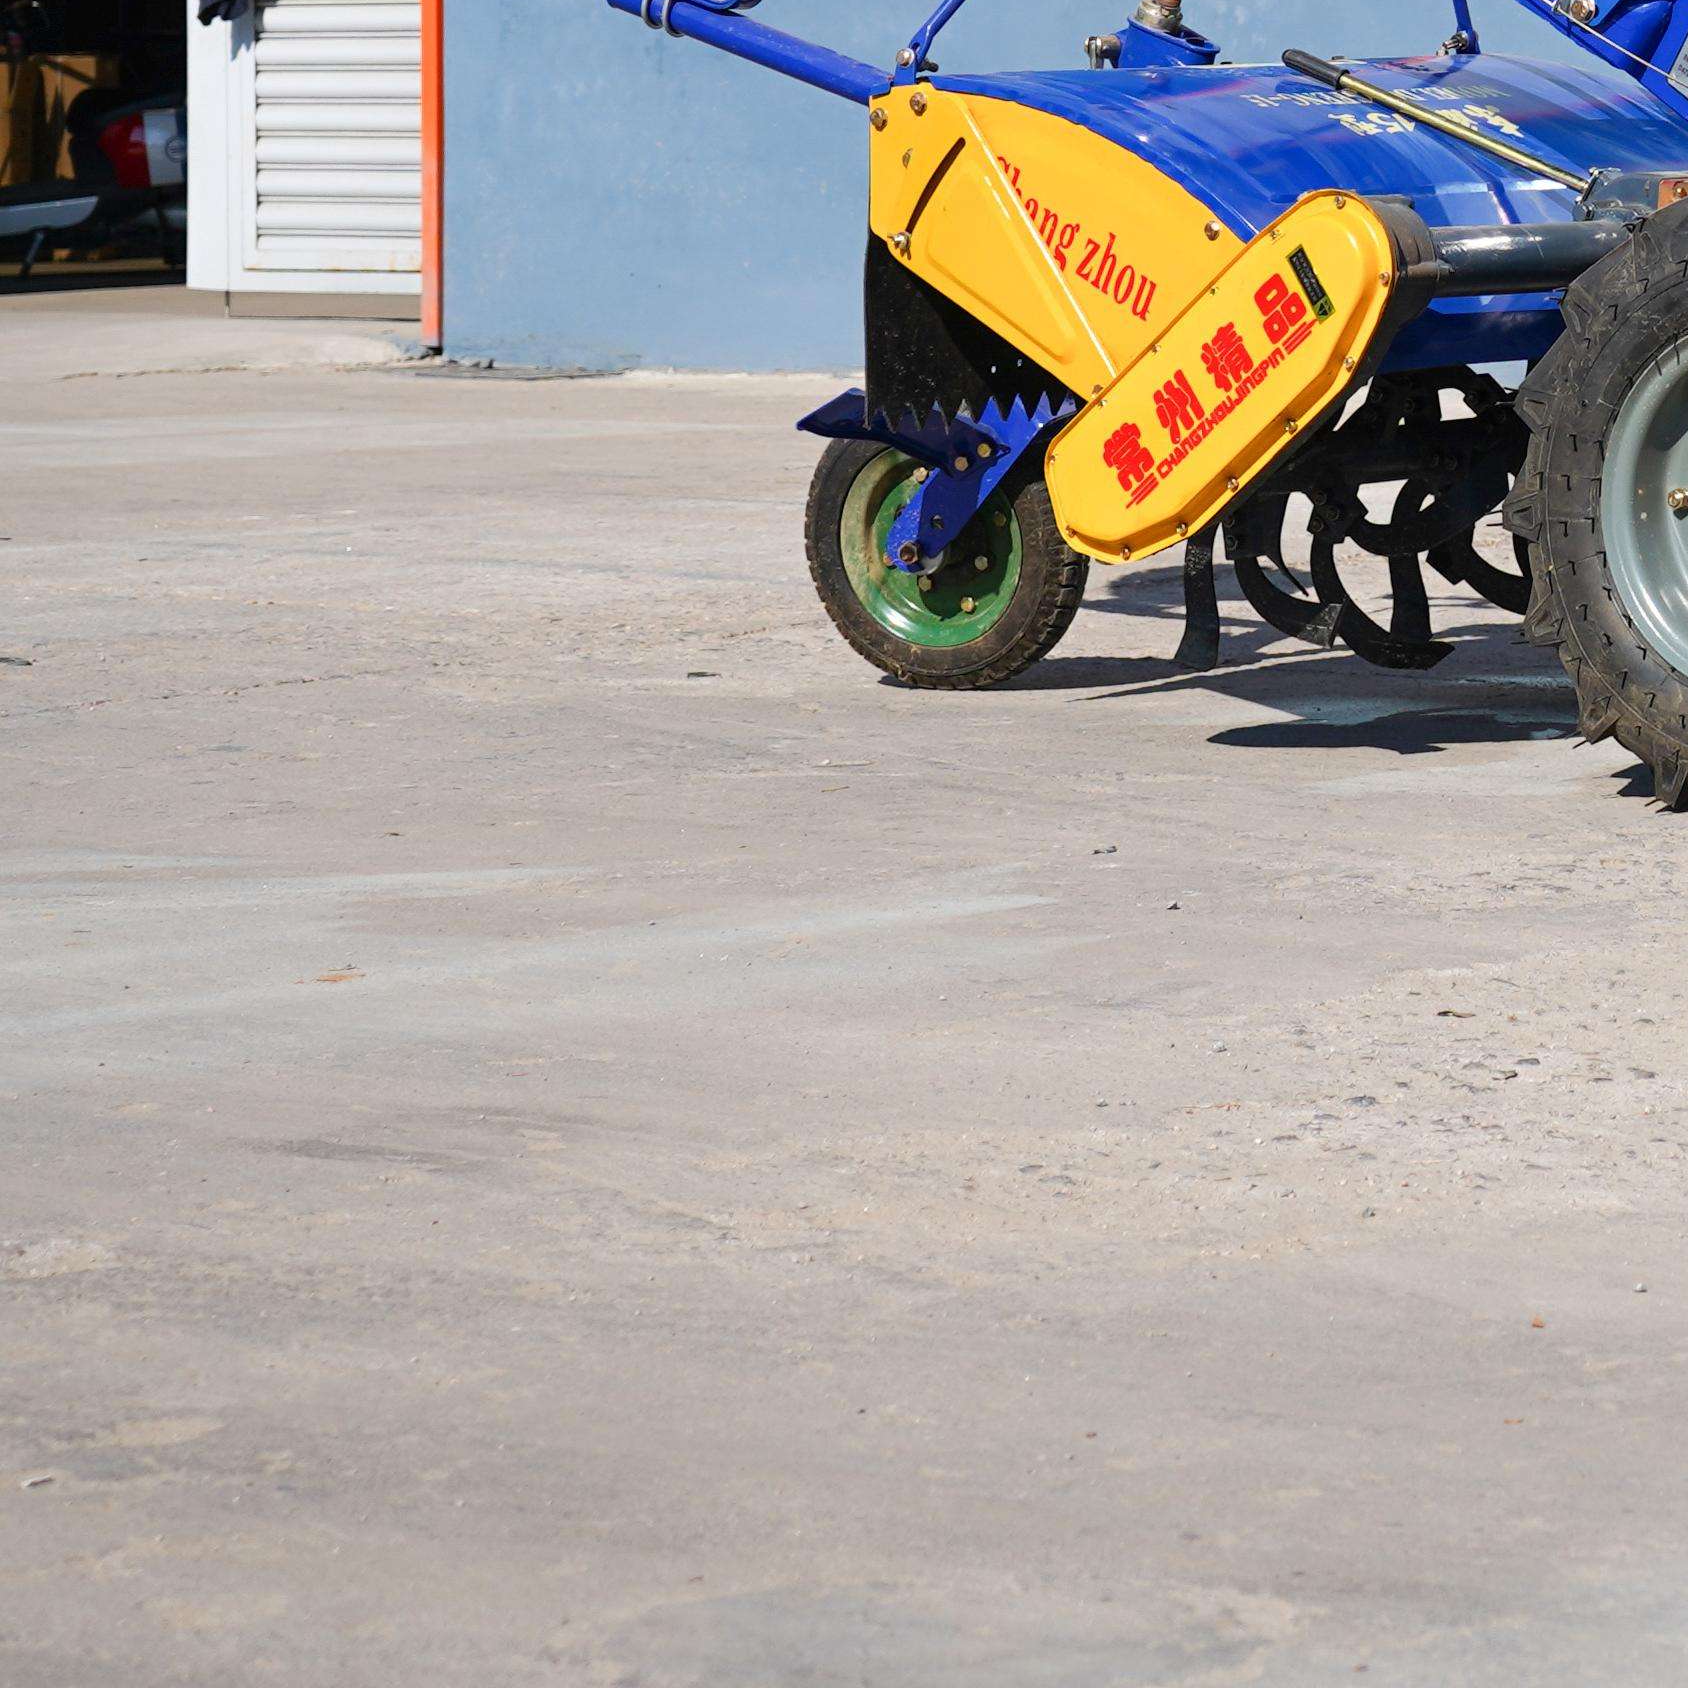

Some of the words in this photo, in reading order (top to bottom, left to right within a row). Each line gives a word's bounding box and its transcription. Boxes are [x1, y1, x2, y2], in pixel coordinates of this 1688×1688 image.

[1075, 232, 1157, 321] zhou
[1103, 272, 1308, 492] 常州精品
[1156, 347, 1286, 479] CHANGZHOUJINGPIN
